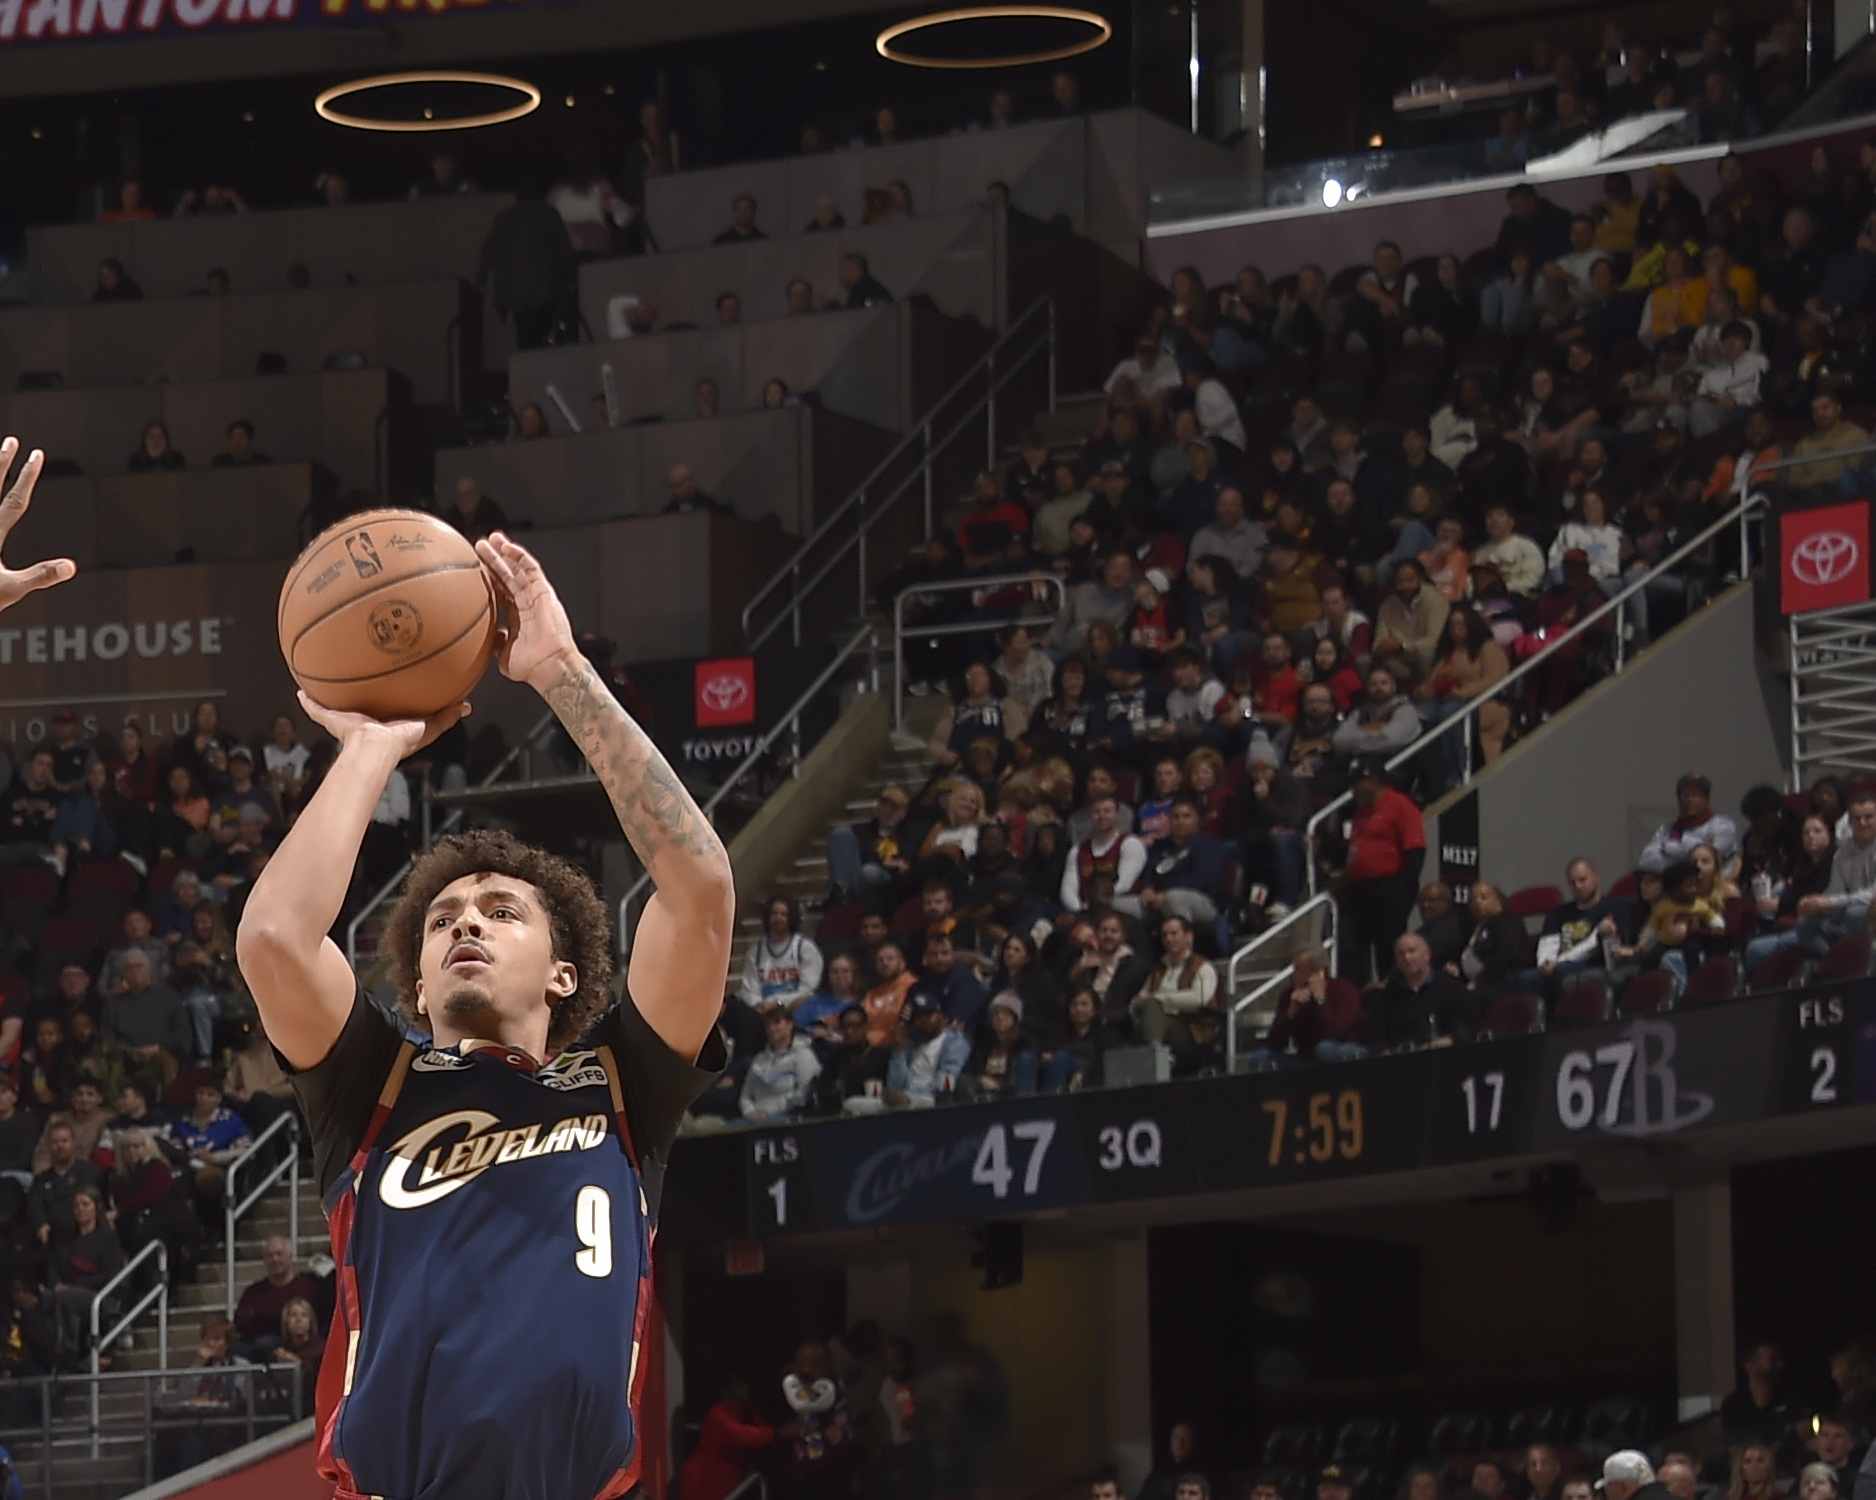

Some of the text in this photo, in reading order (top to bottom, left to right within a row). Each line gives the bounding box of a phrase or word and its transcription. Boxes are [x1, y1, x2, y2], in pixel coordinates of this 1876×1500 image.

[1442, 844, 1477, 867] M117
[1798, 998, 1844, 1031] FLS
[548, 1069, 606, 1090] CLIFFS
[1460, 1071, 1505, 1134] 17
[1556, 1041, 1636, 1132] 67
[1811, 1047, 1838, 1103] 2
[378, 1109, 609, 1210] CLEVELAND
[753, 1137, 801, 1166] FLS
[767, 1176, 788, 1228] 1
[970, 1118, 1057, 1199] 47
[1097, 1120, 1163, 1171] 3Q
[1261, 1088, 1365, 1167] 7:59
[575, 1185, 613, 1278] 9
